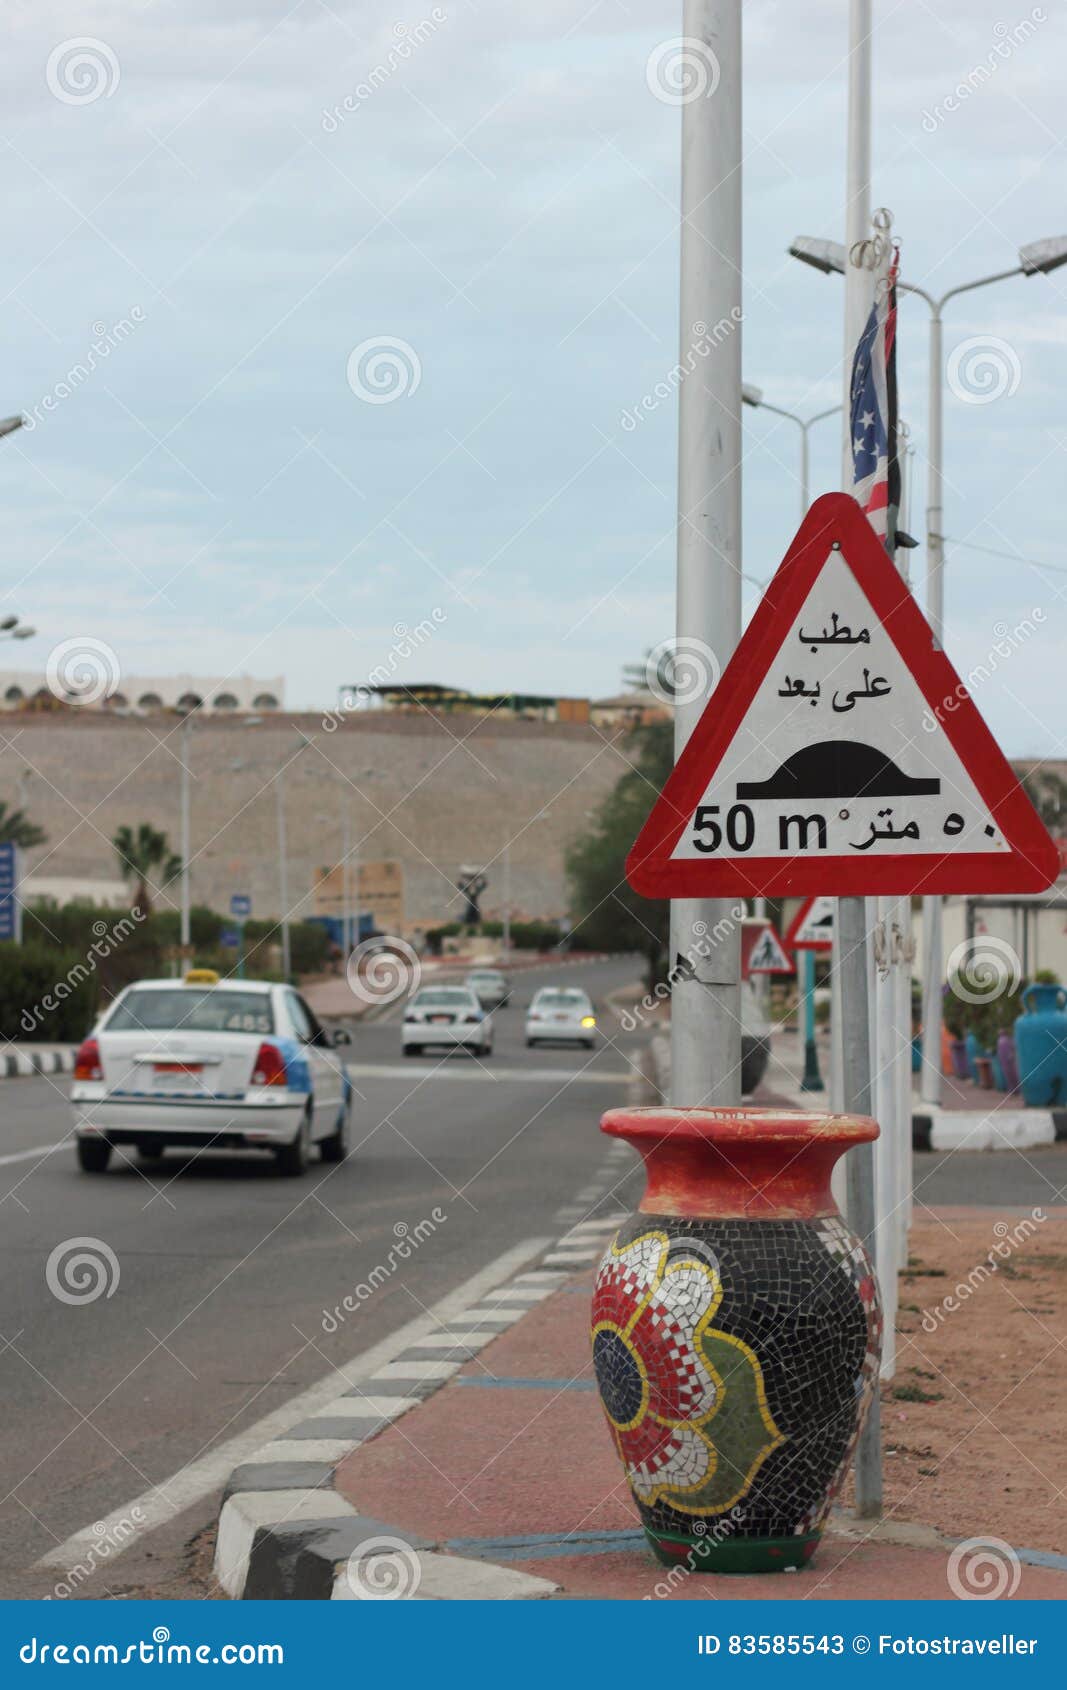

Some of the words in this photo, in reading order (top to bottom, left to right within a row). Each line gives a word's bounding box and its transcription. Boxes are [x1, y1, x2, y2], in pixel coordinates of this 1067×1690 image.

[799, 612, 871, 654] مطب
[778, 675, 820, 707] بعد
[832, 668, 892, 712] على
[692, 804, 755, 853] 50
[779, 813, 827, 850] m
[849, 807, 920, 850] متر
